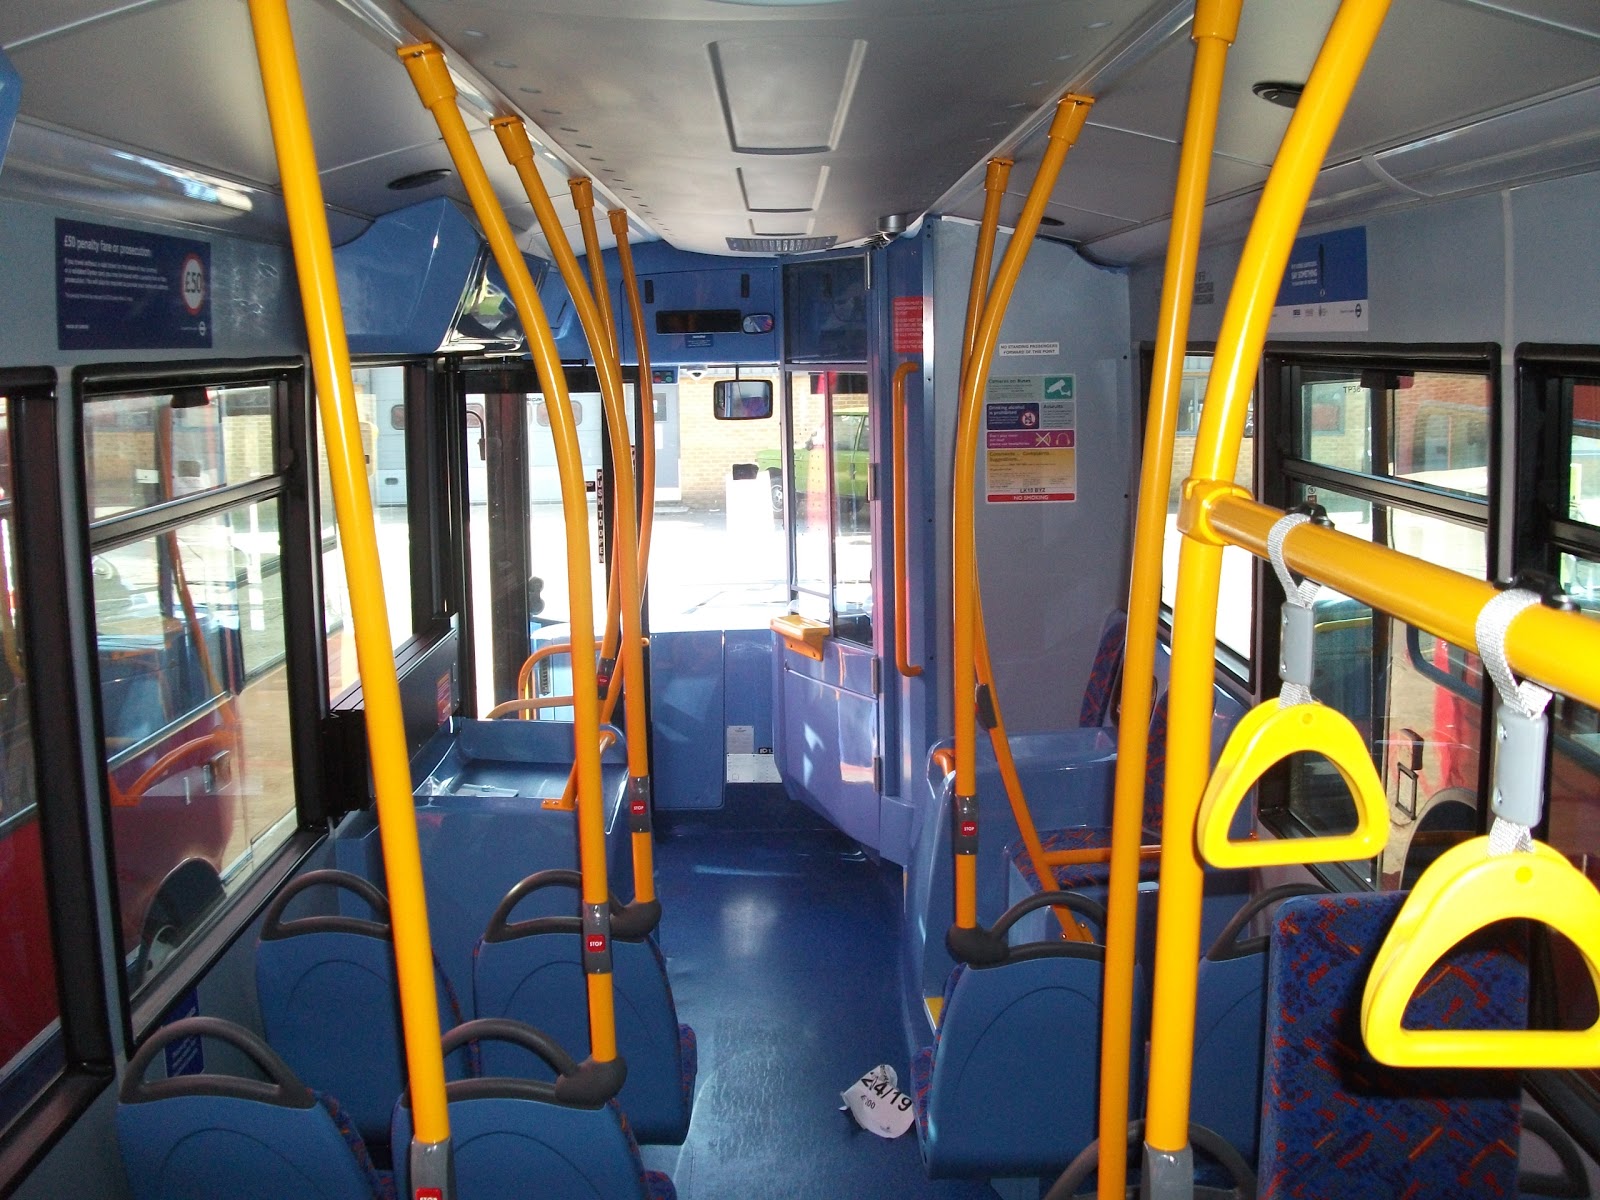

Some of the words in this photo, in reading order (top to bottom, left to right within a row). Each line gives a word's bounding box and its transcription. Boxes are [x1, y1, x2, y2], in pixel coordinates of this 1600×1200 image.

[77, 239, 99, 253] penalty
[100, 239, 112, 253] fare
[112, 243, 119, 253] or
[185, 271, 202, 293] £50
